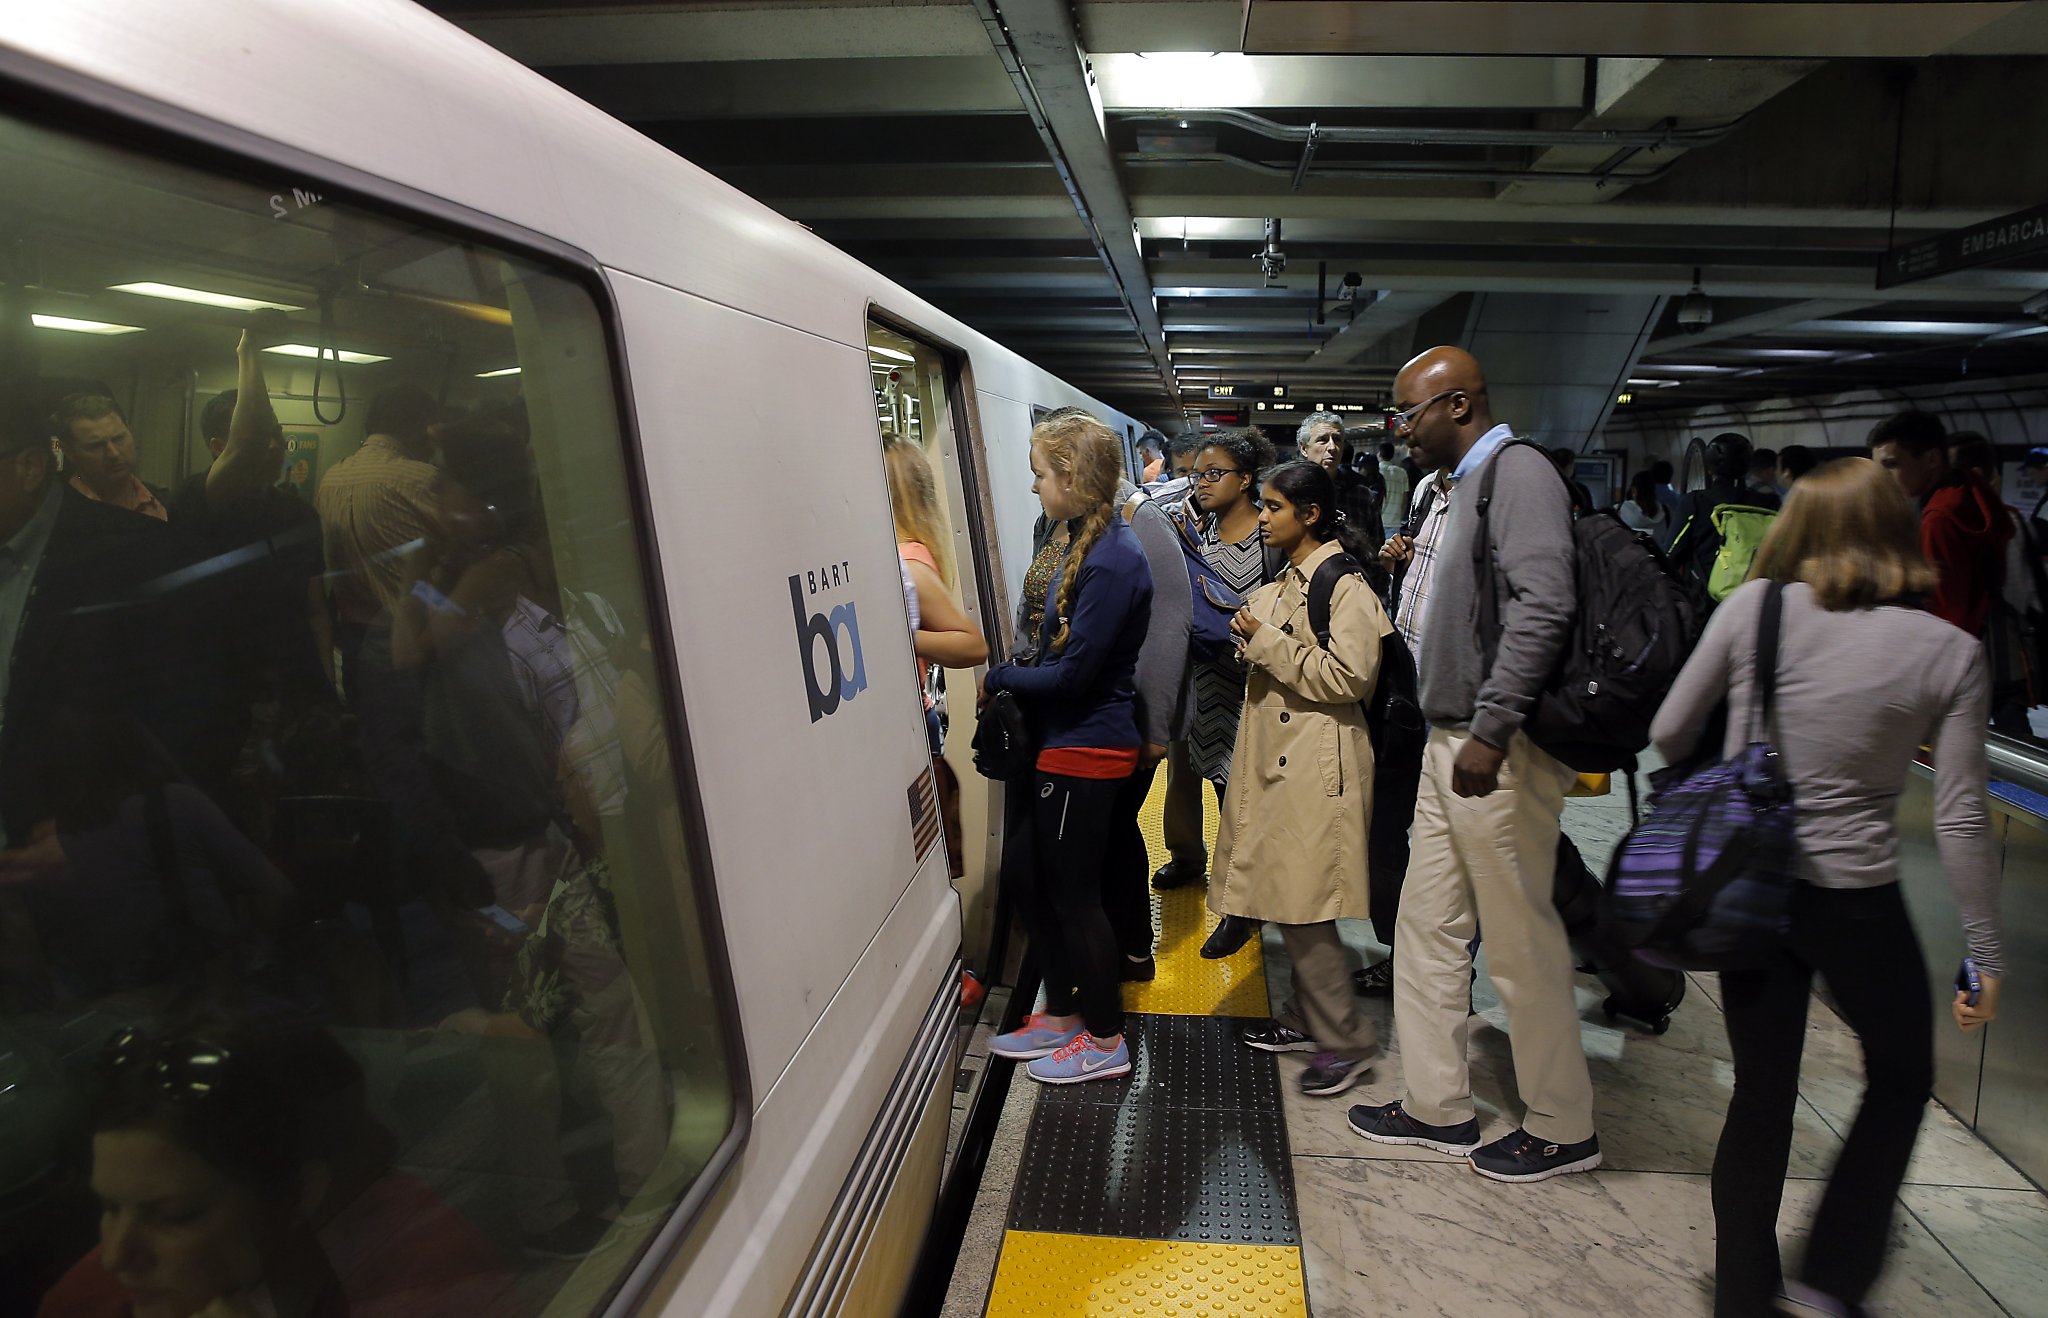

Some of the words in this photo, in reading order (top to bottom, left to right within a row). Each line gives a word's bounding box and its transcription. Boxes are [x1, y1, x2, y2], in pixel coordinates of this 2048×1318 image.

[1961, 216, 2048, 256] EMBARCA
[1214, 386, 1234, 396] EXIT
[1617, 393, 1633, 404] XIT
[807, 561, 850, 595] BART
